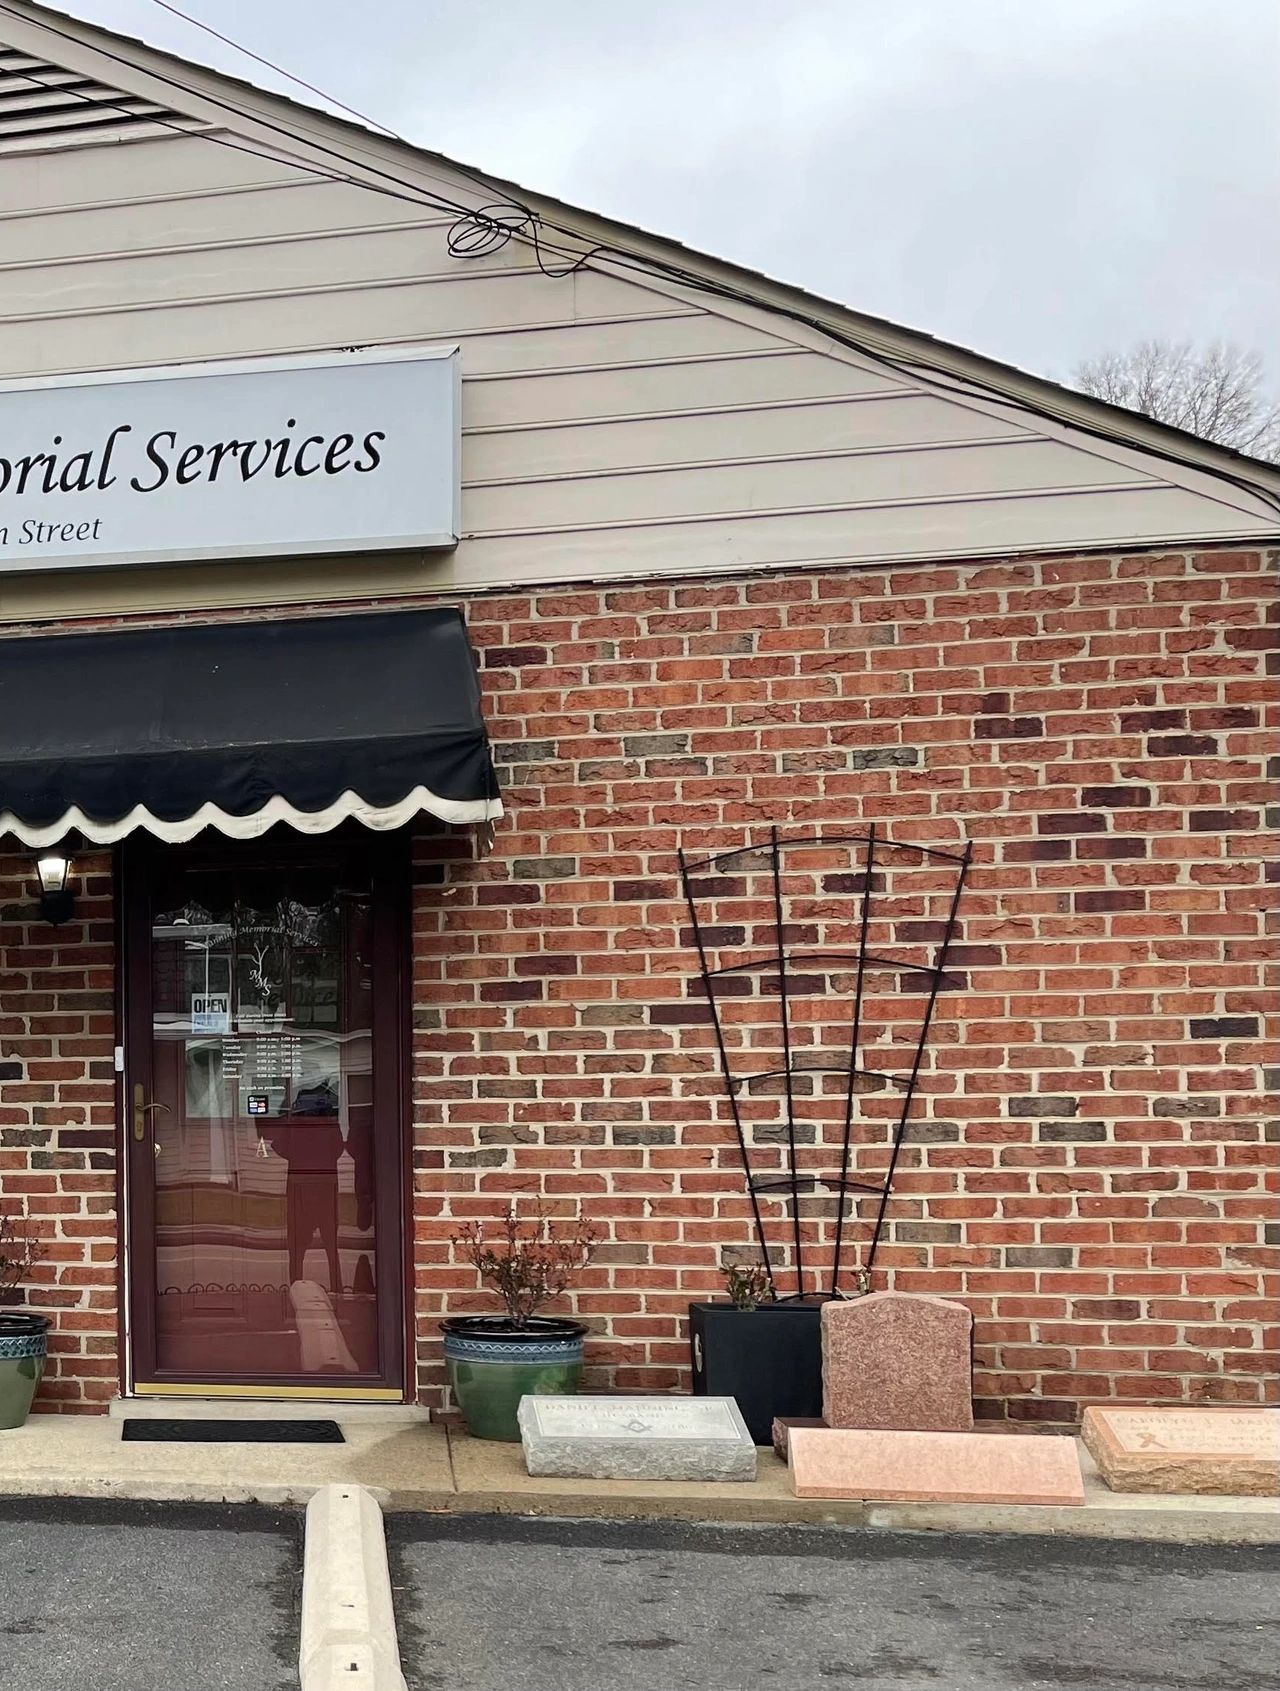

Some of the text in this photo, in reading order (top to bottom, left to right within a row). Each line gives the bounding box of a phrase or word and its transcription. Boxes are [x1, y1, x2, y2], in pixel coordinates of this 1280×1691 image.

[131, 418, 386, 493] Services
[18, 518, 104, 546] Street
[239, 925, 285, 935] Memorial
[286, 928, 320, 948] Services
[194, 999, 227, 1013] OPEN
